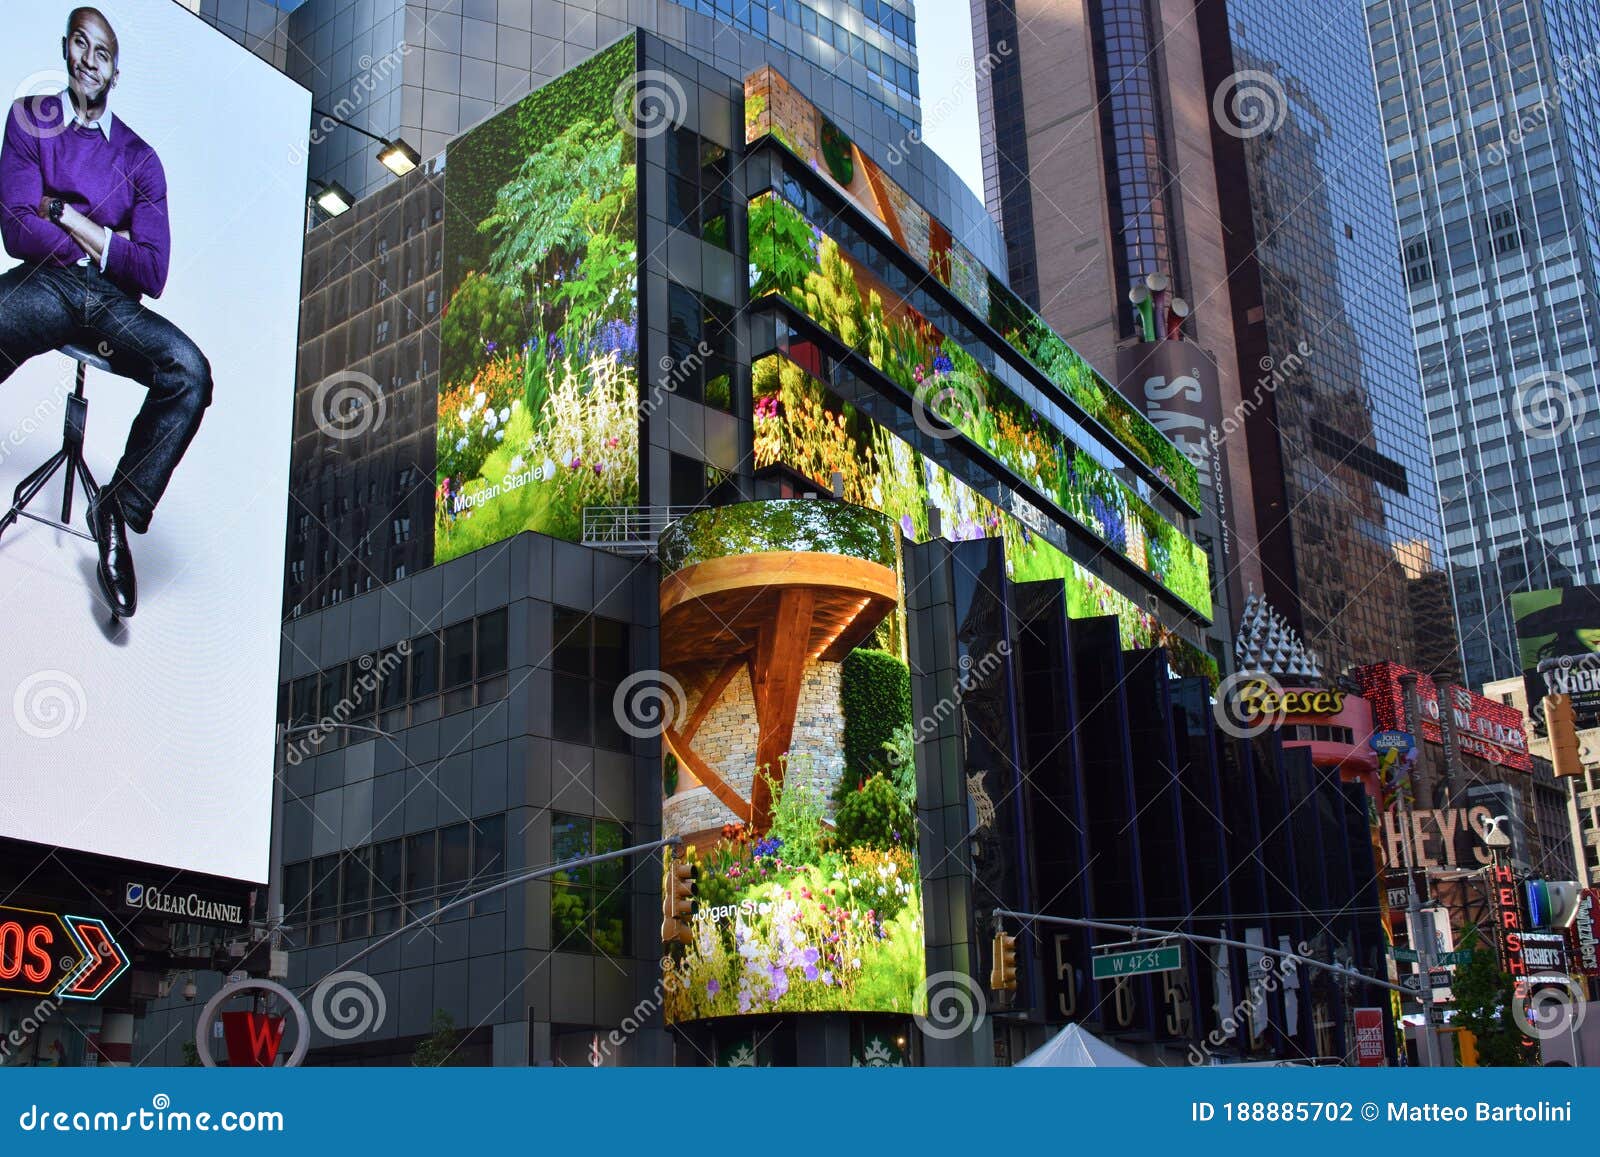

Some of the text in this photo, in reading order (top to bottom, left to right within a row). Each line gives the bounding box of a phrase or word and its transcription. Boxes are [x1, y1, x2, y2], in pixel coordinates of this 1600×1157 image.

[453, 463, 549, 513] Morgan Stanley
[1239, 679, 1345, 714] Reese's
[1379, 805, 1493, 869] HEY'S
[1112, 953, 1160, 972] W 47 St
[230, 1011, 286, 1067] W
